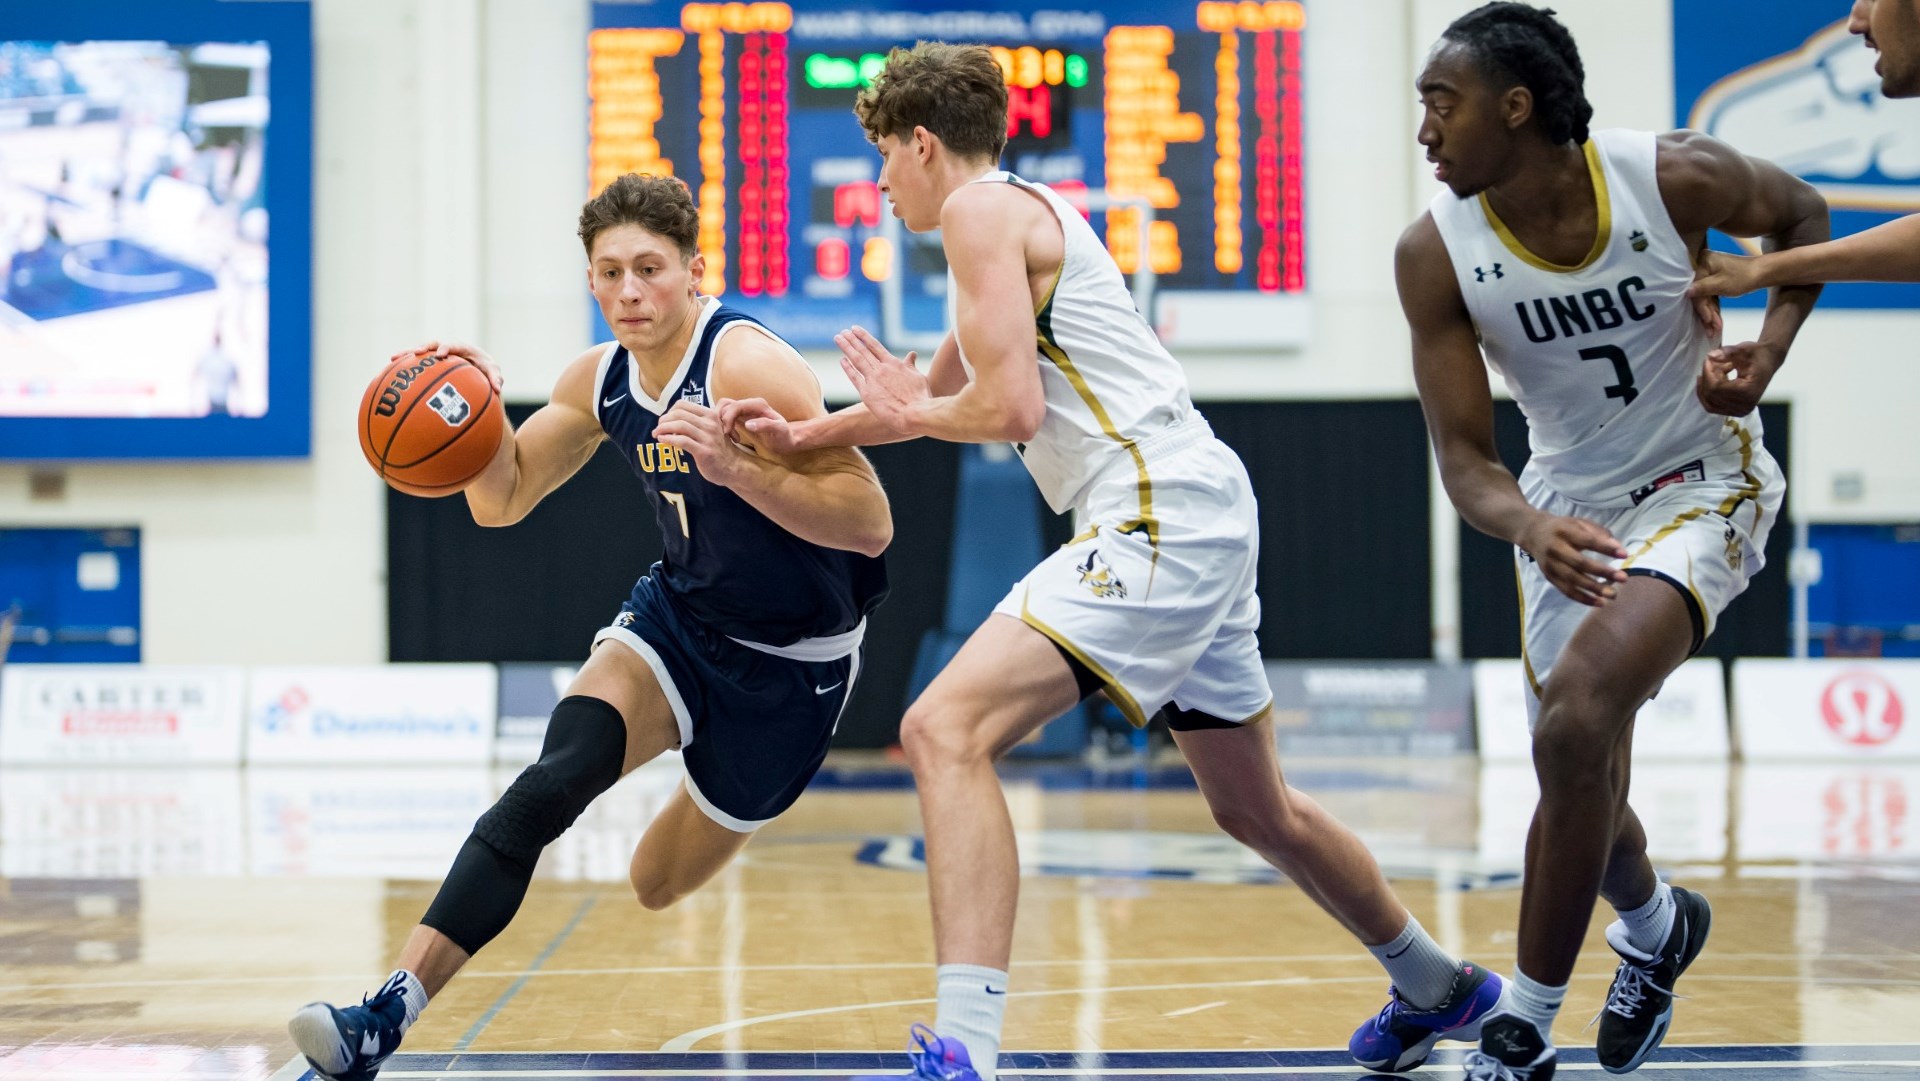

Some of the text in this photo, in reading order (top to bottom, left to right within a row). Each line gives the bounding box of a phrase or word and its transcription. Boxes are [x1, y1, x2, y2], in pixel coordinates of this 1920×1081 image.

[1515, 276, 1656, 343] UNBC
[1578, 344, 1639, 408] 3
[440, 394, 463, 418] SPORTS
[637, 443, 690, 473] UBC
[660, 490, 690, 539] 7
